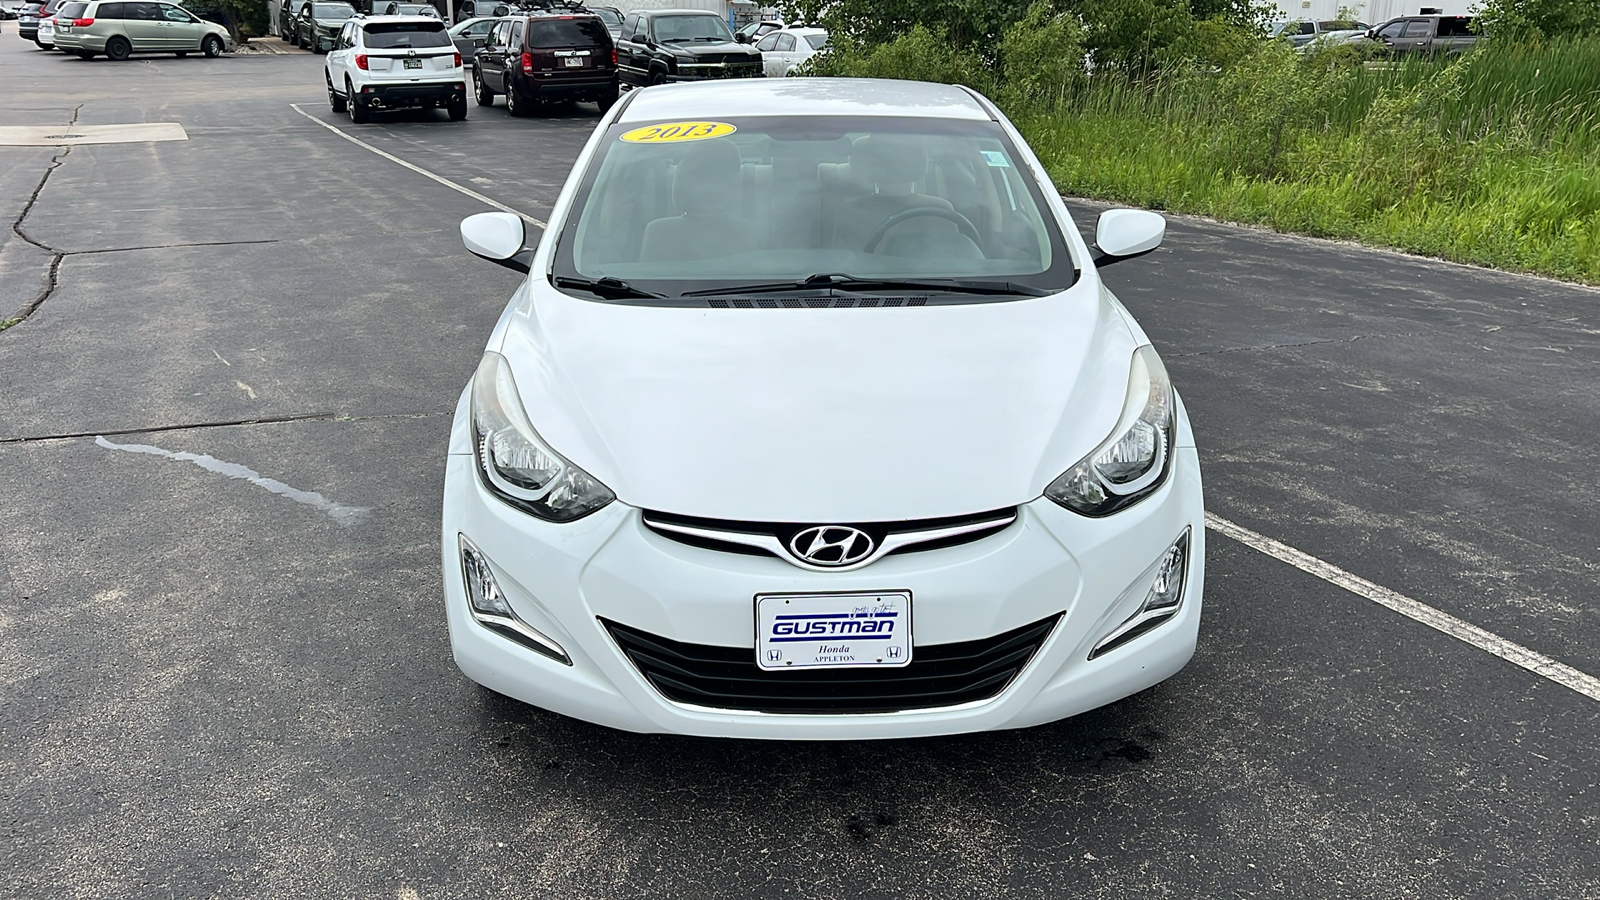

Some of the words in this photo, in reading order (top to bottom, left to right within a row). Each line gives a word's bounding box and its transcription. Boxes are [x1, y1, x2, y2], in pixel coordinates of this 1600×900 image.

[638, 124, 718, 141] 2013
[818, 645, 850, 654] Honda
[813, 655, 855, 663] APPLETON
